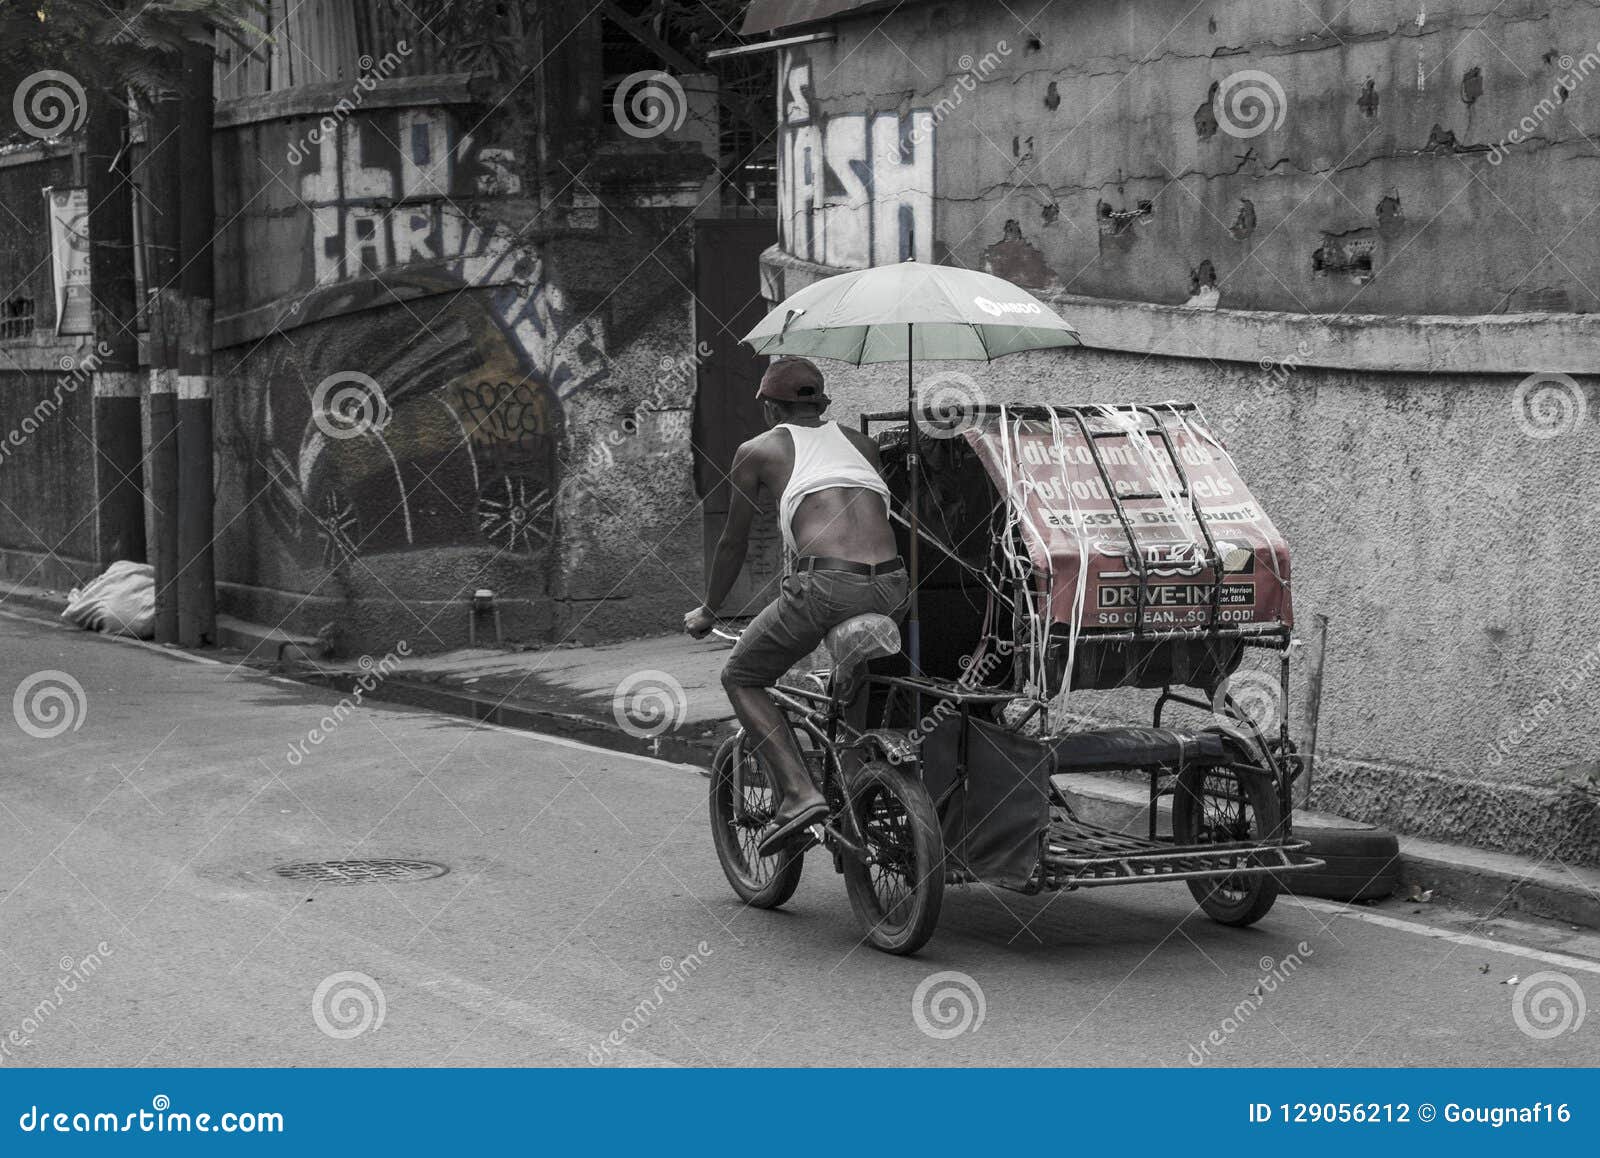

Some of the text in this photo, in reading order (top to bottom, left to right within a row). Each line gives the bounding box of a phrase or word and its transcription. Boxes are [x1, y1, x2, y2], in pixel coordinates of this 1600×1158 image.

[1229, 586, 1253, 594] Harrison
[1230, 595, 1246, 603] EDSA
[1099, 611, 1120, 624] SO
